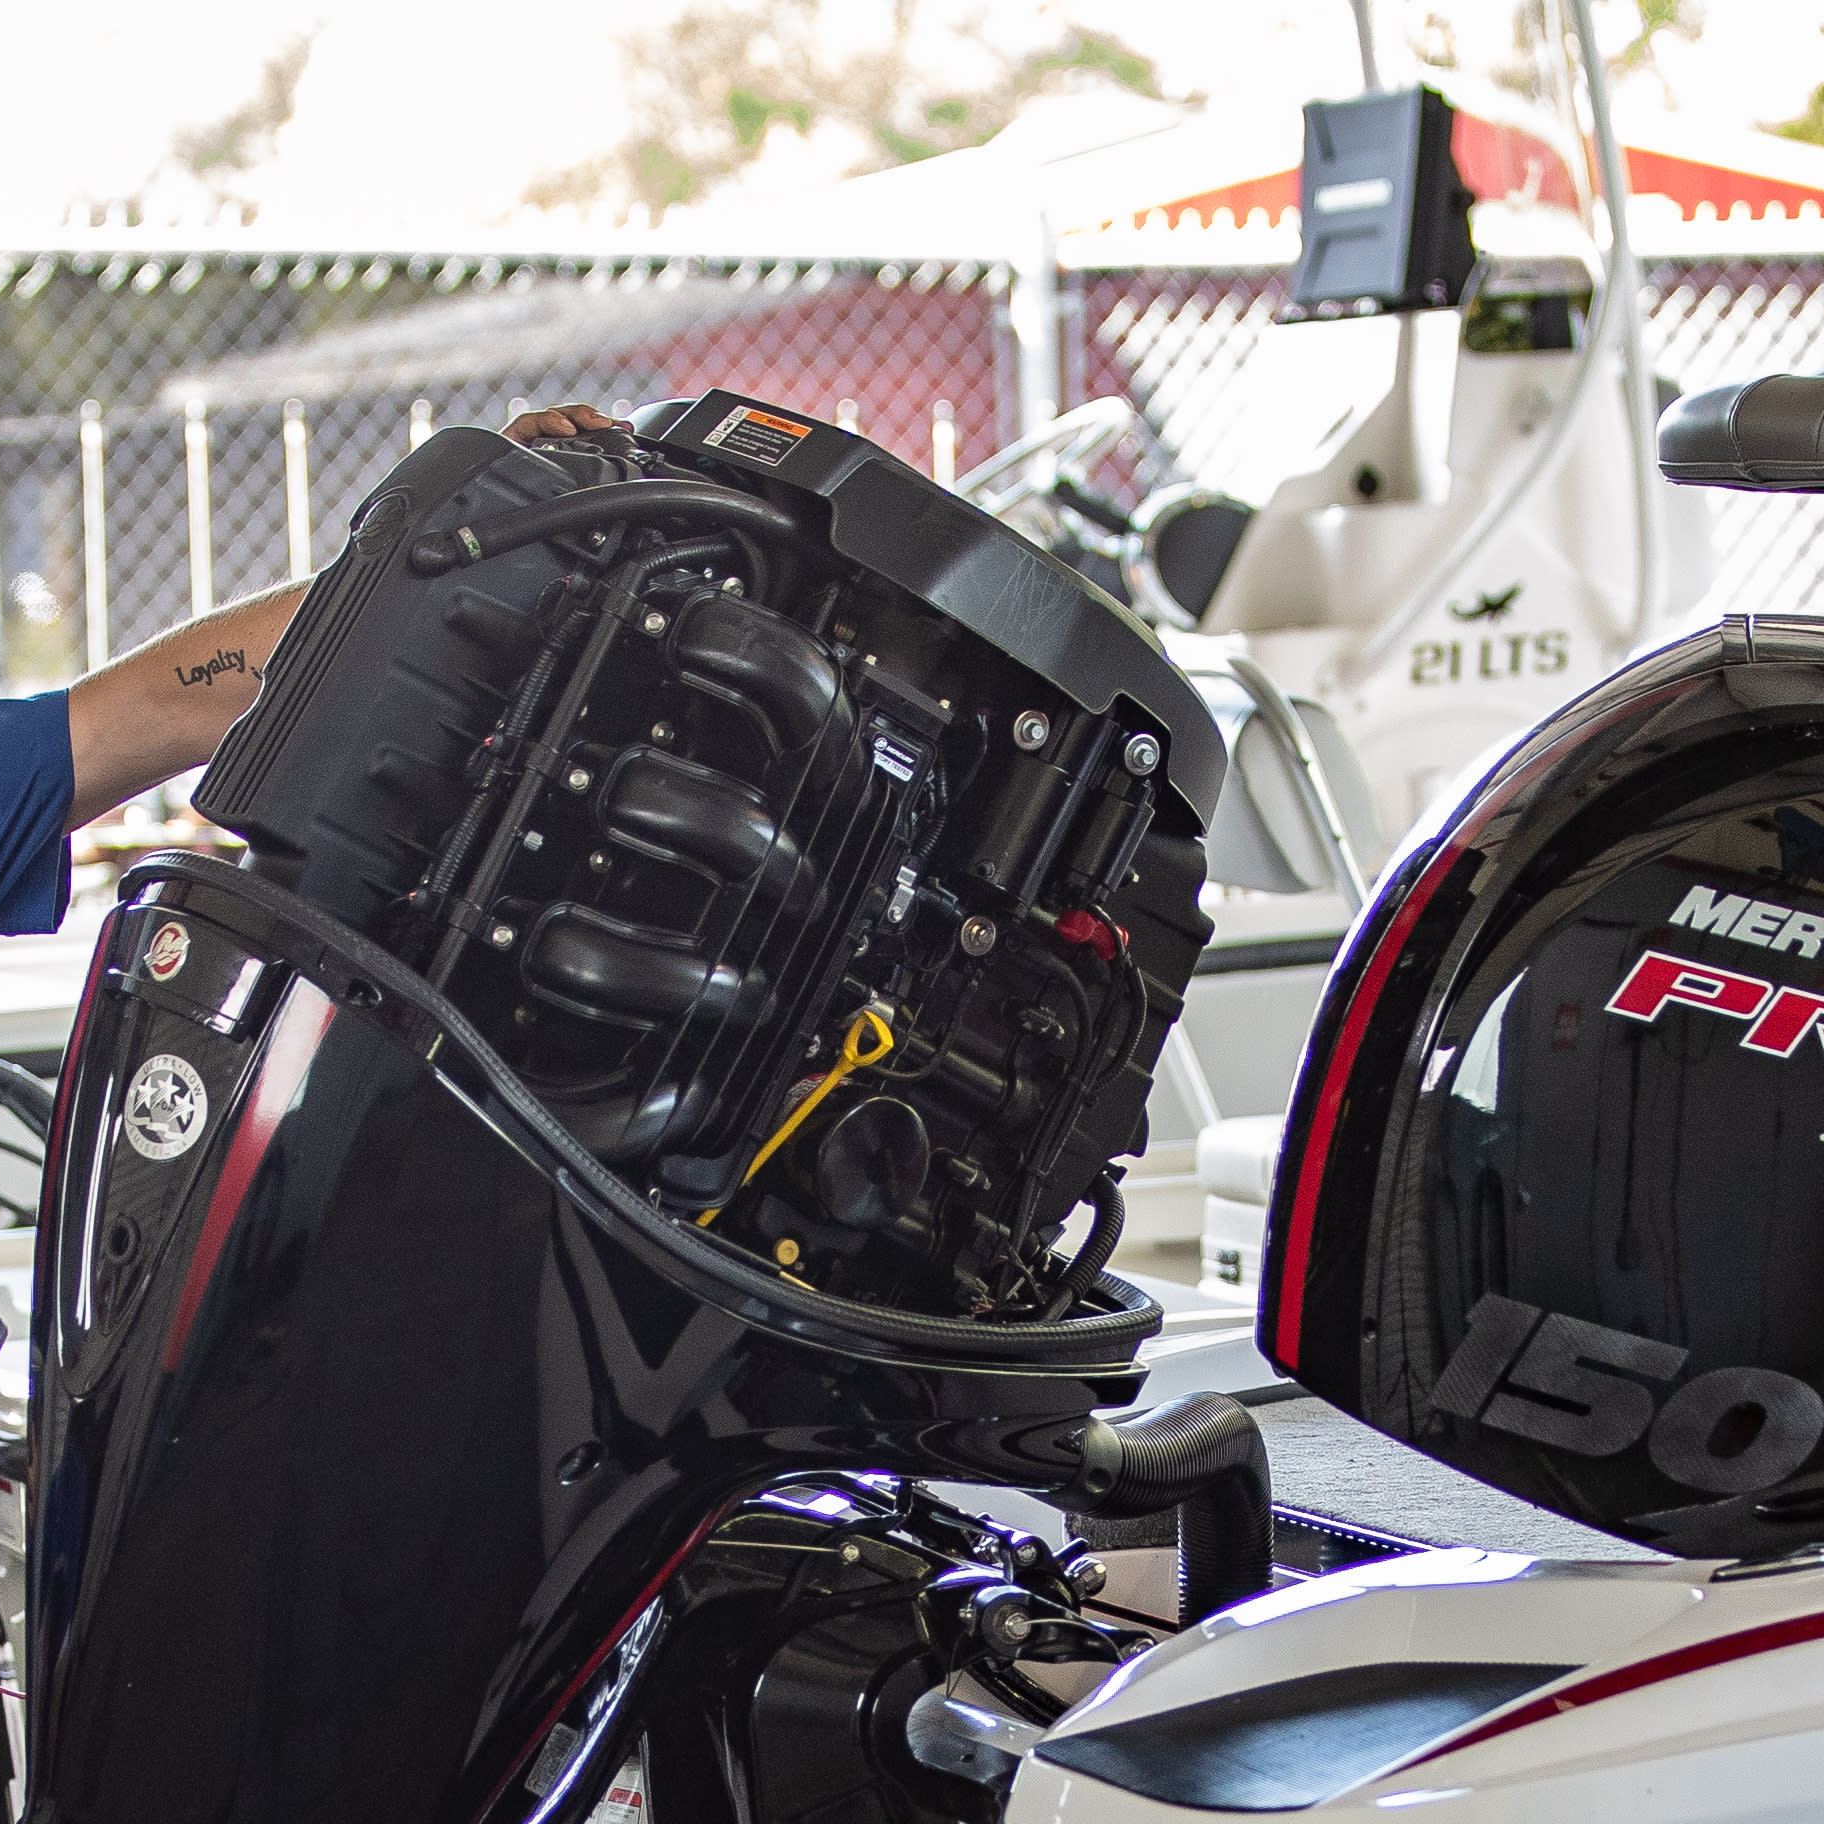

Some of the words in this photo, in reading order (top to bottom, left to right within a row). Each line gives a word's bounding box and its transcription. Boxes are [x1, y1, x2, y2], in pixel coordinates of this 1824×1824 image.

[174, 648, 246, 687] Loyalty
[1410, 641, 1462, 685] 21
[1479, 630, 1569, 679] LTS
[183, 1069, 203, 1097] LOW
